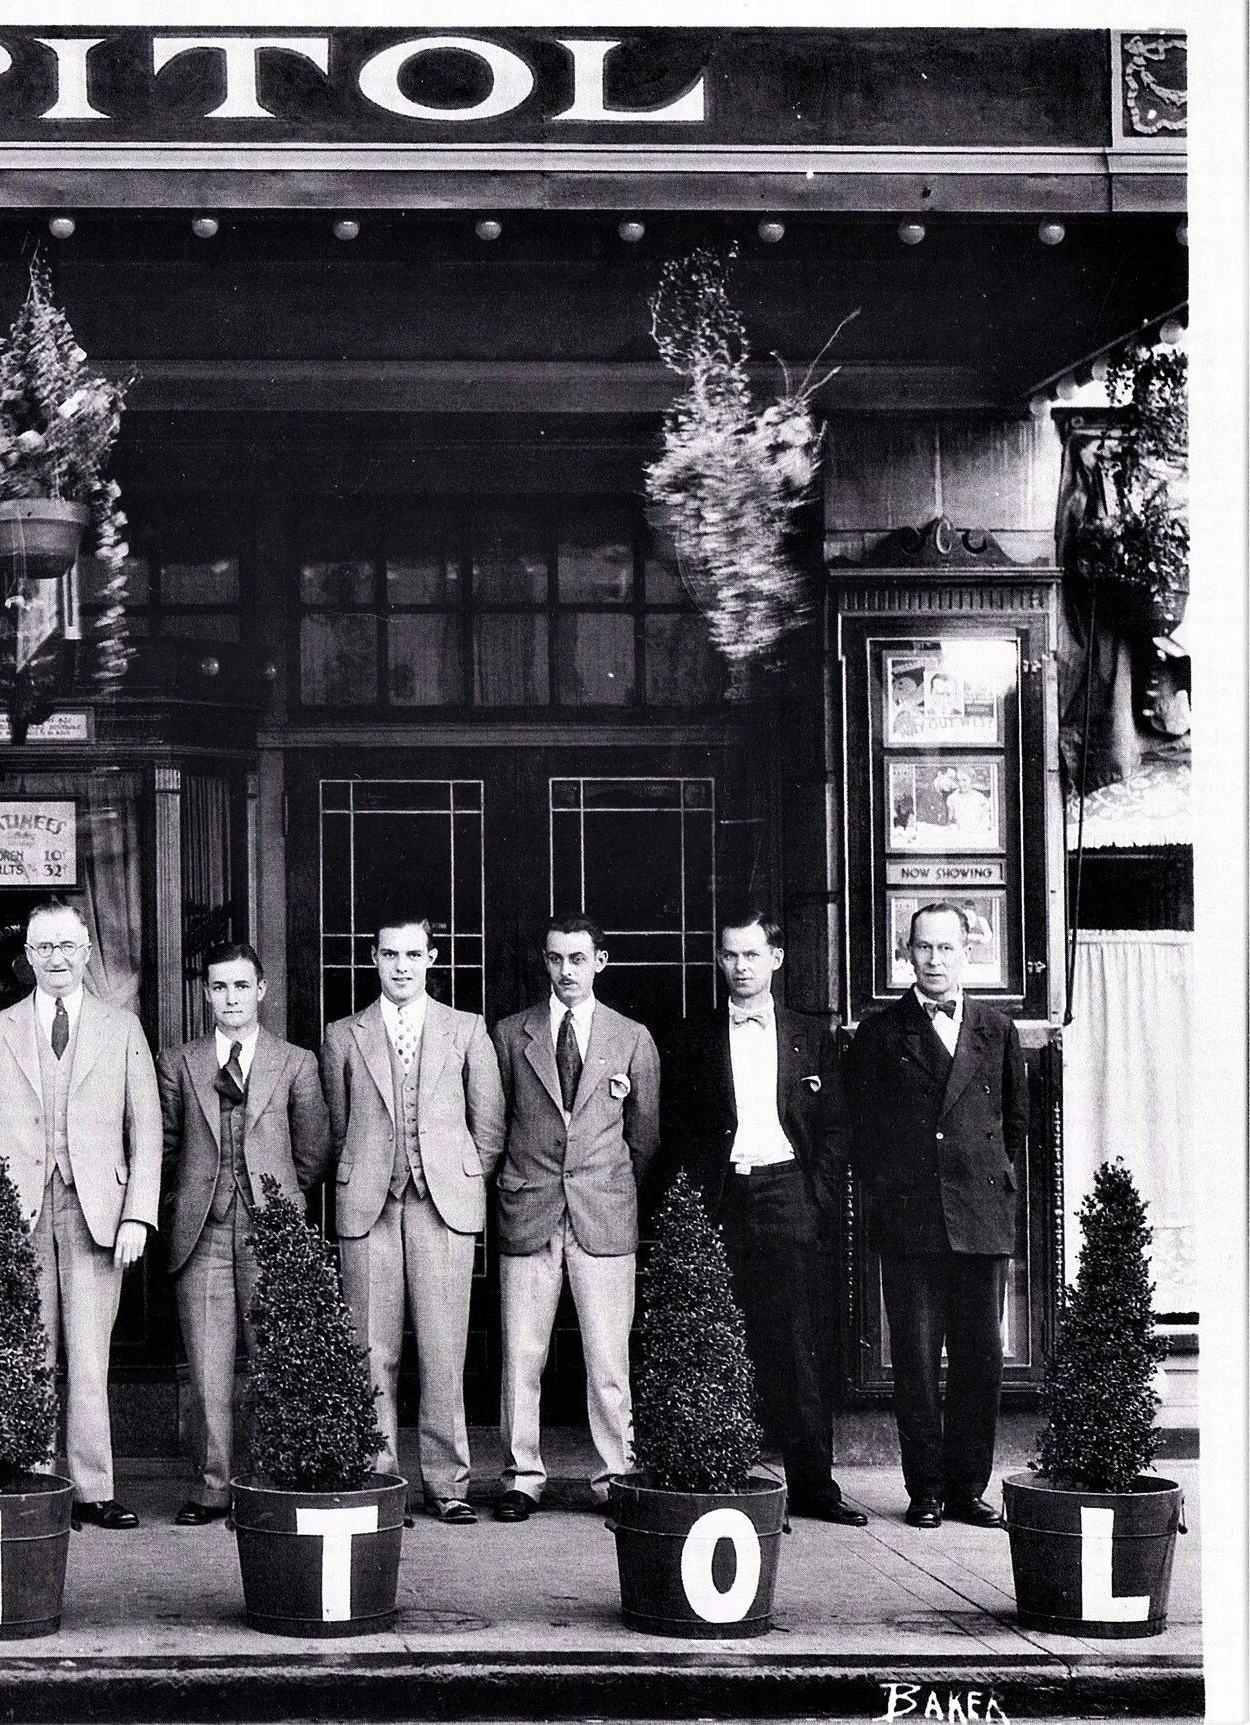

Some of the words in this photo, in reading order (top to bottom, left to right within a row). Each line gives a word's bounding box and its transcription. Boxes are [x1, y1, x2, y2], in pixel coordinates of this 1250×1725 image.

[901, 868, 930, 879] NOW
[936, 867, 993, 879] SHOWING
[295, 1506, 379, 1622] T
[680, 1508, 762, 1624] O
[1080, 1506, 1151, 1623] L
